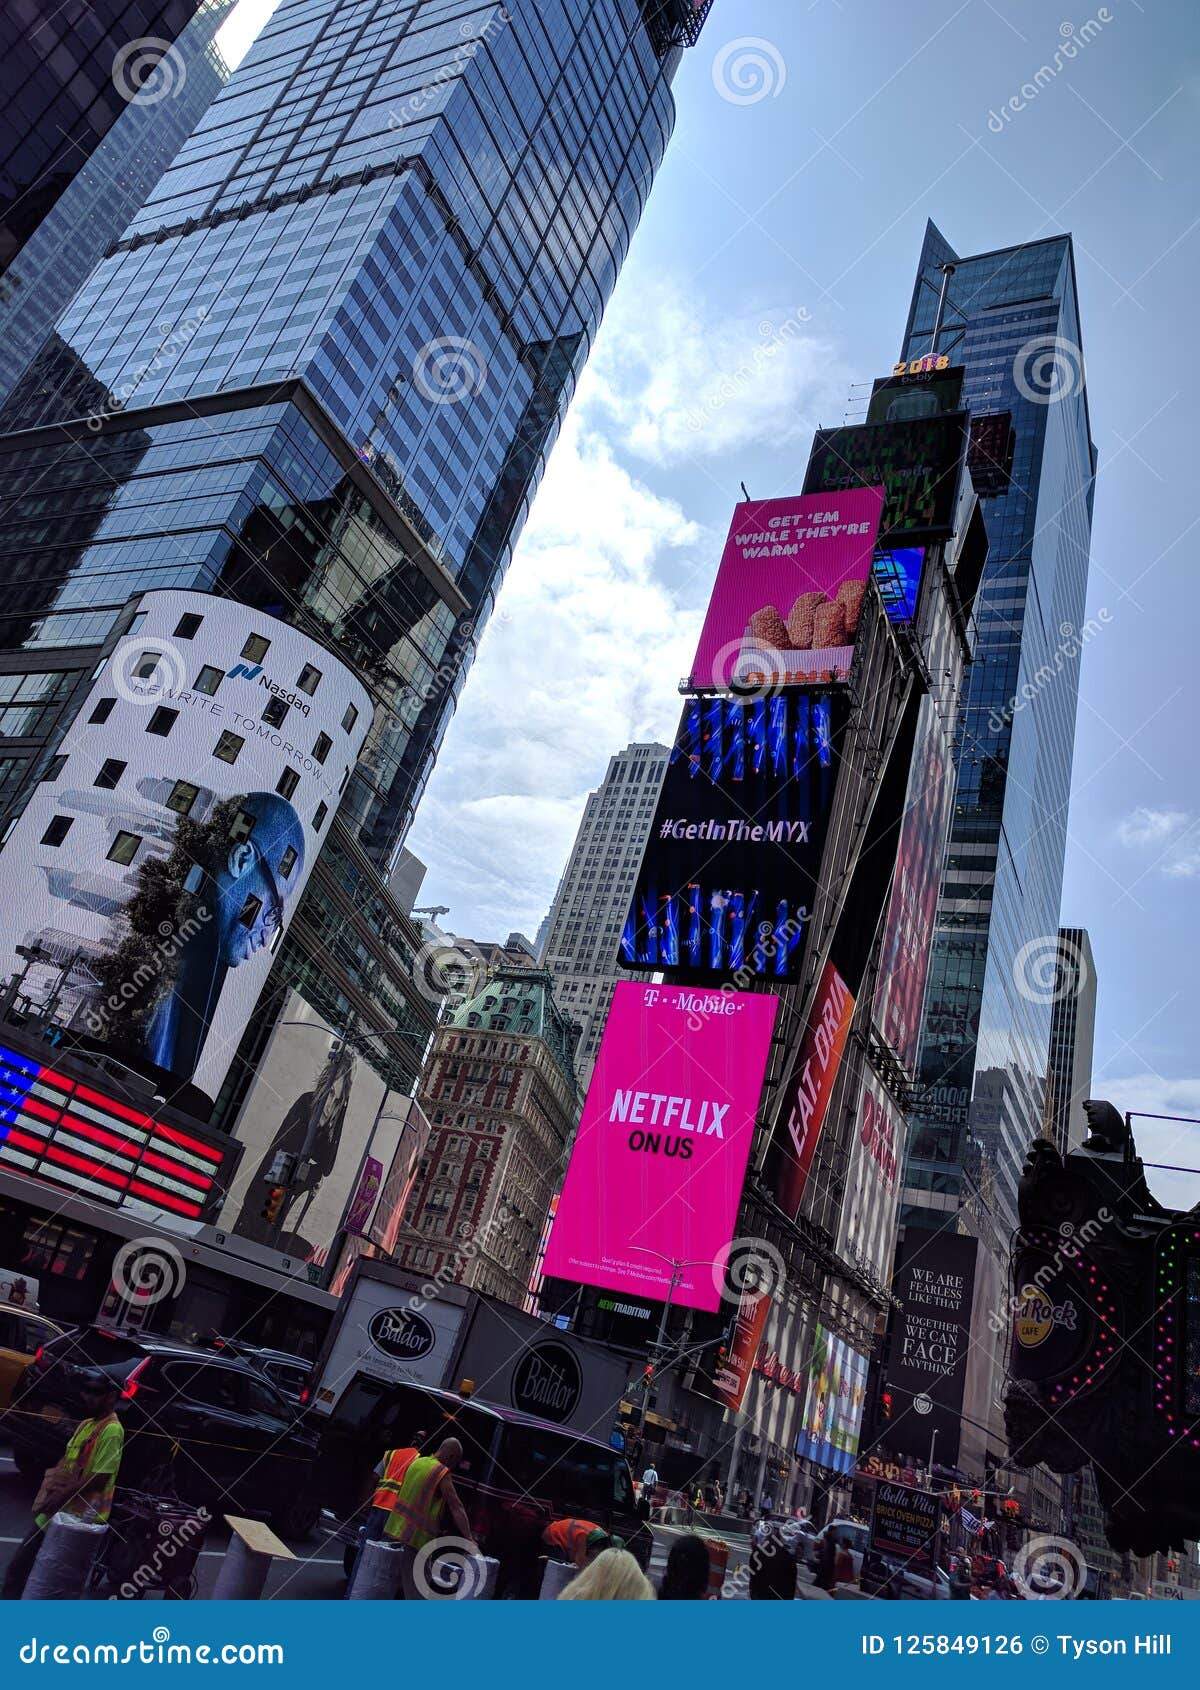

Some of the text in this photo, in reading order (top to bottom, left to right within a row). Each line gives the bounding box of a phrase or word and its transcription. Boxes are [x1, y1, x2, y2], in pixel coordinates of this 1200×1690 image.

[893, 355, 949, 376] 2018
[735, 521, 870, 546] WHILE THEY'RE
[768, 514, 803, 529] GET
[258, 675, 311, 718] Nasdaq
[132, 684, 323, 780] REWRITE TOMORROW
[659, 818, 812, 843] #GetInTheMYX
[608, 1088, 730, 1139] NETFLIX
[628, 1130, 694, 1159] ON US
[909, 1280, 963, 1300] FEARLESS
[912, 1267, 964, 1289] WE ARE
[908, 1291, 962, 1311] LIKE THAT
[905, 1313, 959, 1333] TOGETHER
[1031, 1298, 1077, 1331] Rock
[376, 1315, 429, 1351] Baldor
[905, 1324, 958, 1346] WE CAN
[1021, 1327, 1040, 1336] CAFE
[902, 1337, 957, 1366] FACE
[900, 1357, 955, 1377] ANYTHING
[521, 1356, 576, 1411] Baldor
[878, 1484, 936, 1515] Bella Vita
[875, 1504, 935, 1529] BRICK OVEN PIZZA
